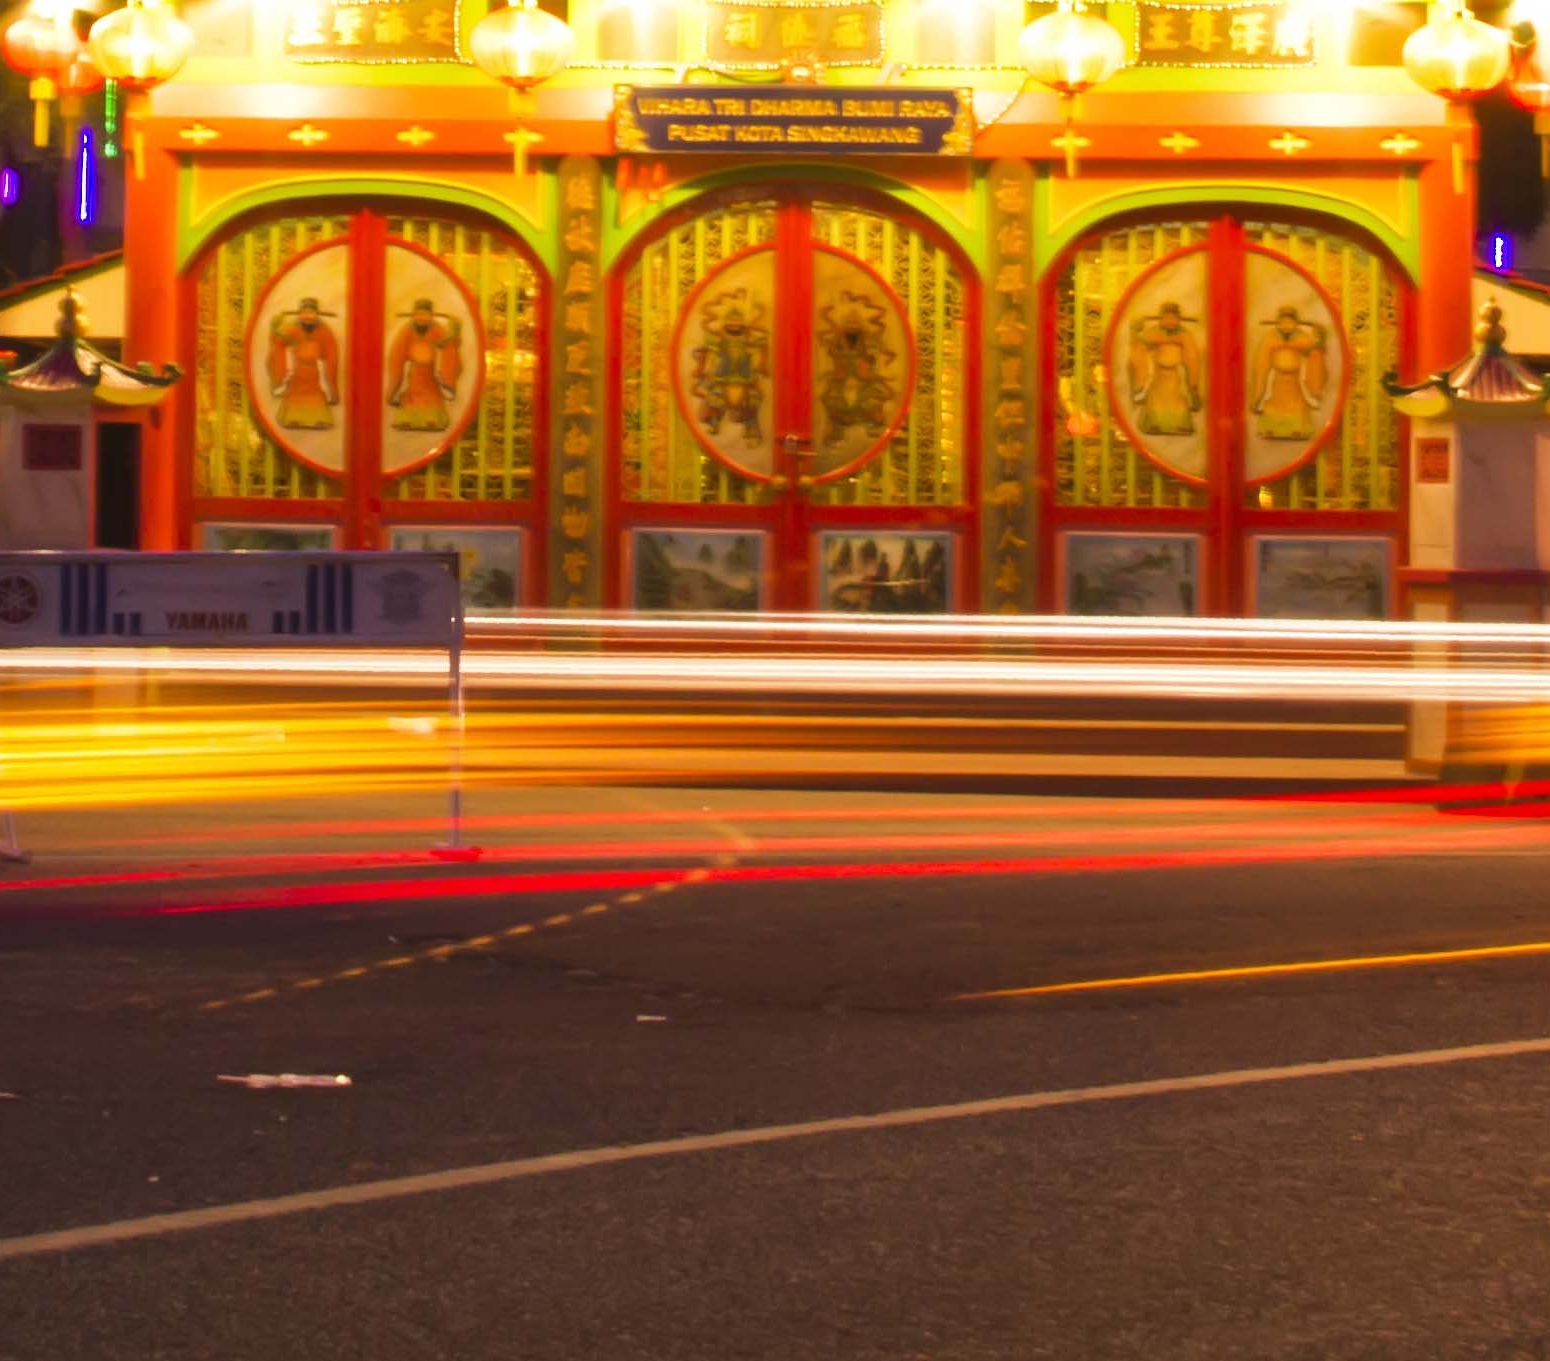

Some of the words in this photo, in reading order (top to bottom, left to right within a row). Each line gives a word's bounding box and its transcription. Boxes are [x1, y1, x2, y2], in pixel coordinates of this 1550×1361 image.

[637, 98, 711, 115] VIHARA
[713, 99, 746, 115] TRI
[749, 99, 838, 116] DHARMA
[842, 100, 894, 117] BUMI
[899, 100, 953, 118] RAYA
[668, 124, 730, 141] PUSAT
[733, 125, 784, 142] KOTA
[787, 125, 924, 144] SINGKAWANG
[165, 612, 248, 631] YAMAHA
